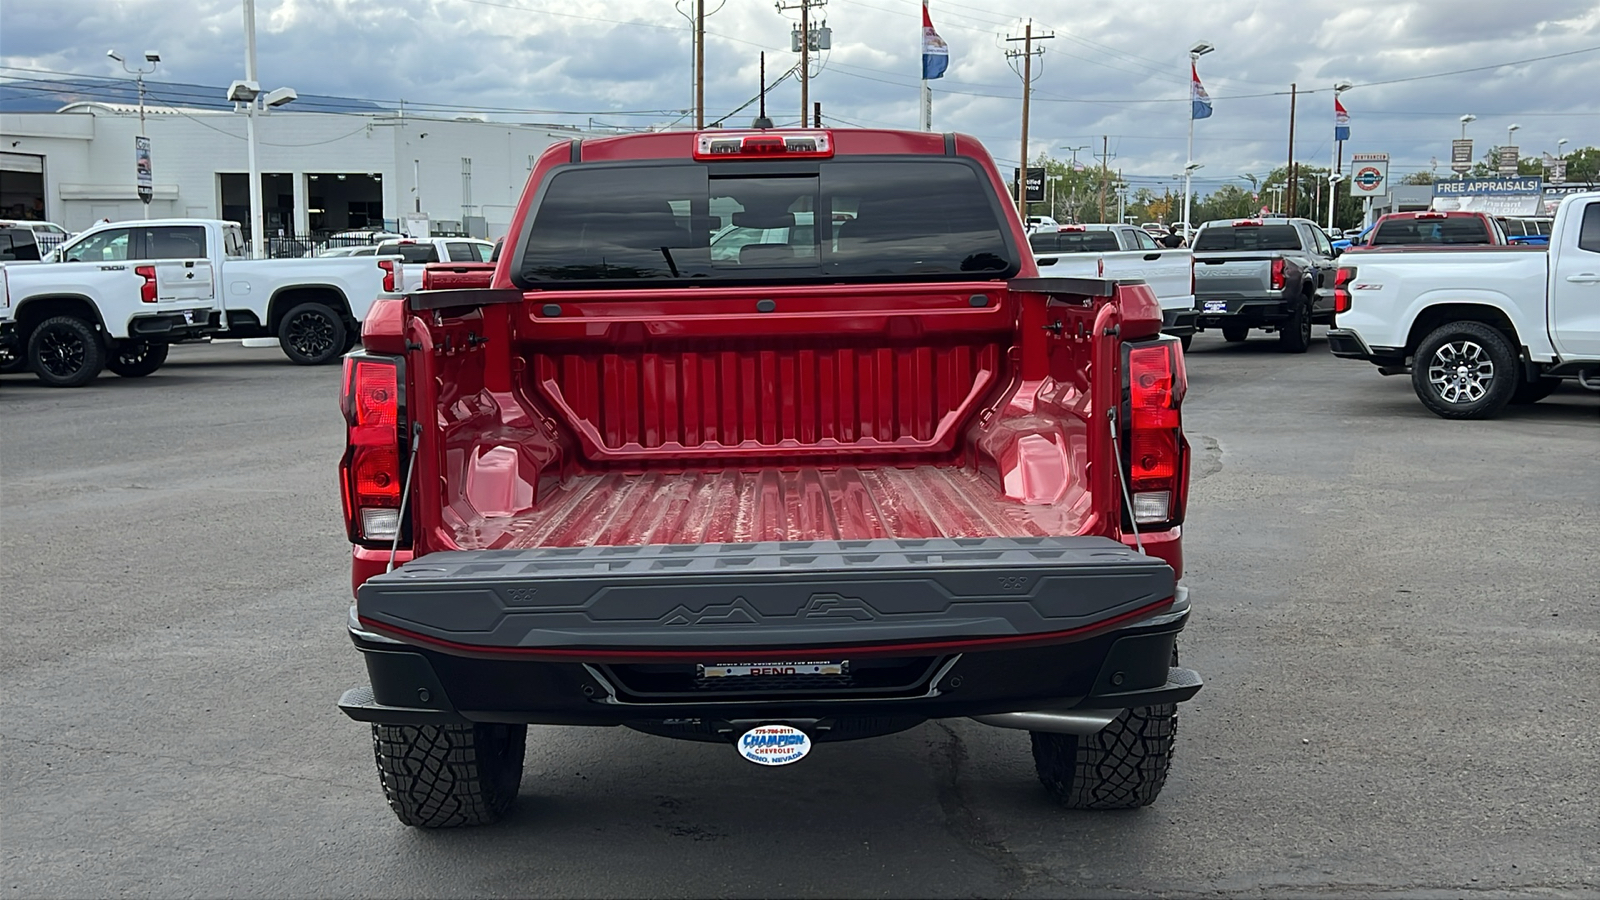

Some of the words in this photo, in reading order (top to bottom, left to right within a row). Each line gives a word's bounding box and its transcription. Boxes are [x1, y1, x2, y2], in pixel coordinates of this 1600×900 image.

[1437, 182, 1465, 193] FREE
[1467, 181, 1538, 192] APPRAISALS!
[1484, 200, 1521, 208] Instant
[750, 667, 795, 676] RENO
[743, 734, 805, 747] CHAMPION
[746, 751, 770, 763] RENO,
[771, 751, 803, 763] NEVADA
